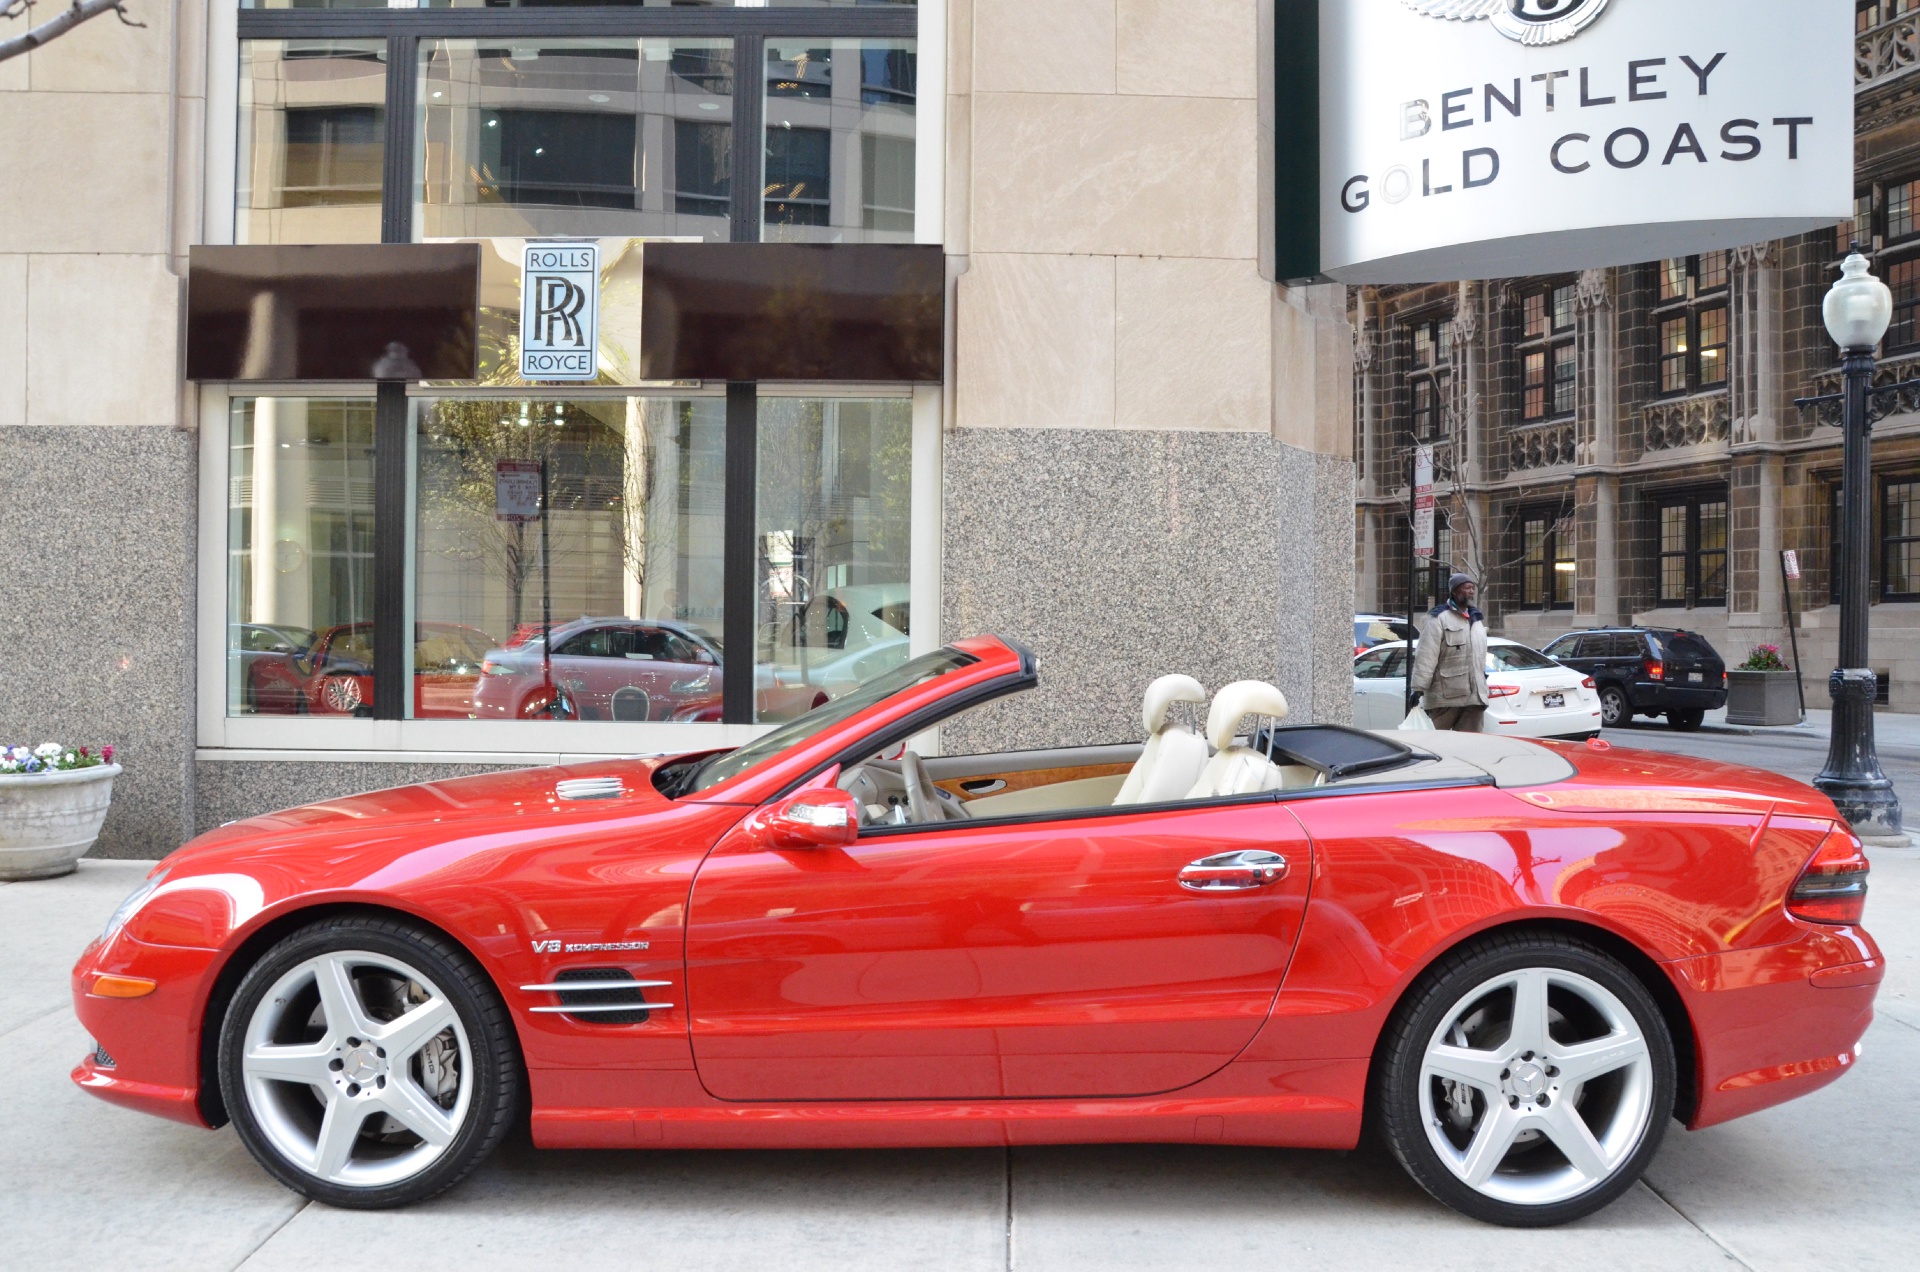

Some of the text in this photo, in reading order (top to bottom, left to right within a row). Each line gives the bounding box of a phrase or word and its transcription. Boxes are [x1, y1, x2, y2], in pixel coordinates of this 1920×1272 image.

[1400, 52, 1728, 141] BENTLEY
[1340, 116, 1814, 213] GOLD COAST
[530, 252, 590, 268] ROLLS
[527, 355, 588, 370] ROYCE
[531, 940, 650, 953] V8 KOMPRESSOR
[424, 1043, 436, 1075] AMG
